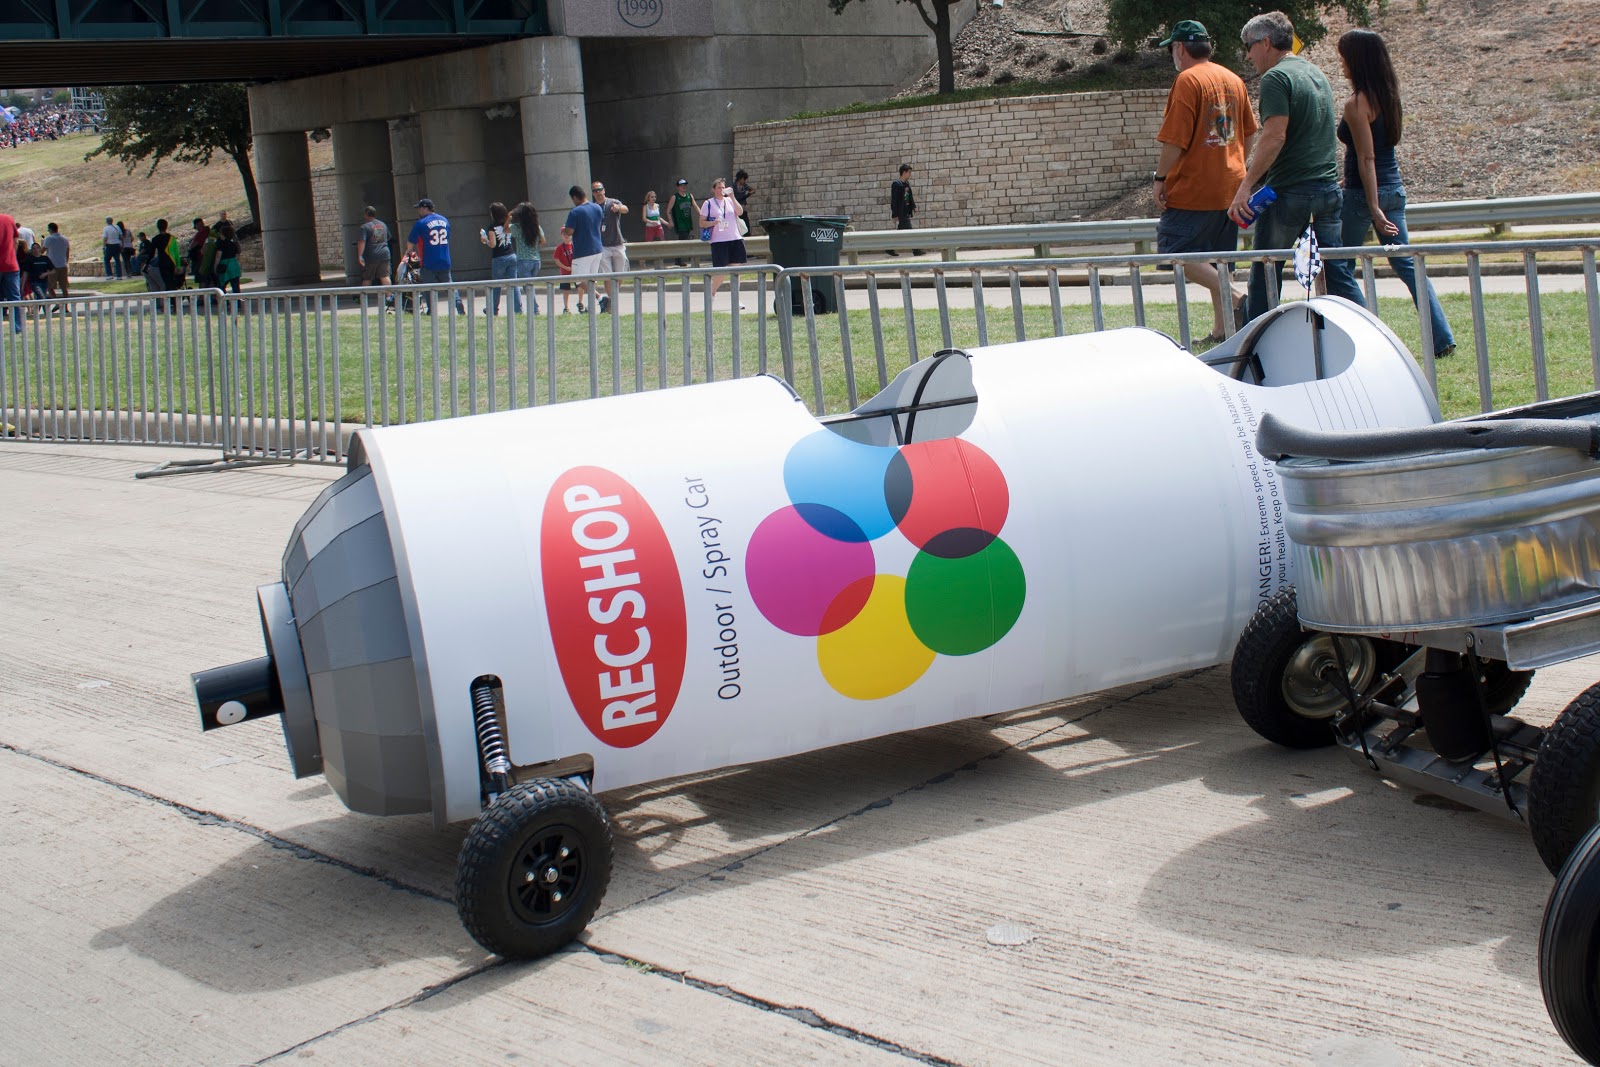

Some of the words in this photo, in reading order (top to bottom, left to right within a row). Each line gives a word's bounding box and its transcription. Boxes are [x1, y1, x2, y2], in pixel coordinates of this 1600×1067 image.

[624, 0, 657, 16] 1999
[430, 228, 448, 246] 32
[1216, 381, 1241, 425] hazardous
[1237, 389, 1258, 427] children.
[1237, 426, 1247, 438] be
[1241, 440, 1254, 459] may
[1247, 461, 1263, 493] speed,
[1262, 469, 1274, 478] of
[1267, 480, 1278, 497] out
[684, 476, 709, 508] Car
[1257, 495, 1270, 536] Extreme
[1273, 499, 1283, 525] Keep
[697, 515, 731, 579] Spray
[1275, 526, 1286, 561] health.
[1278, 562, 1288, 583] your
[563, 484, 658, 731] RECSHOP
[713, 603, 742, 700] Outdoor
